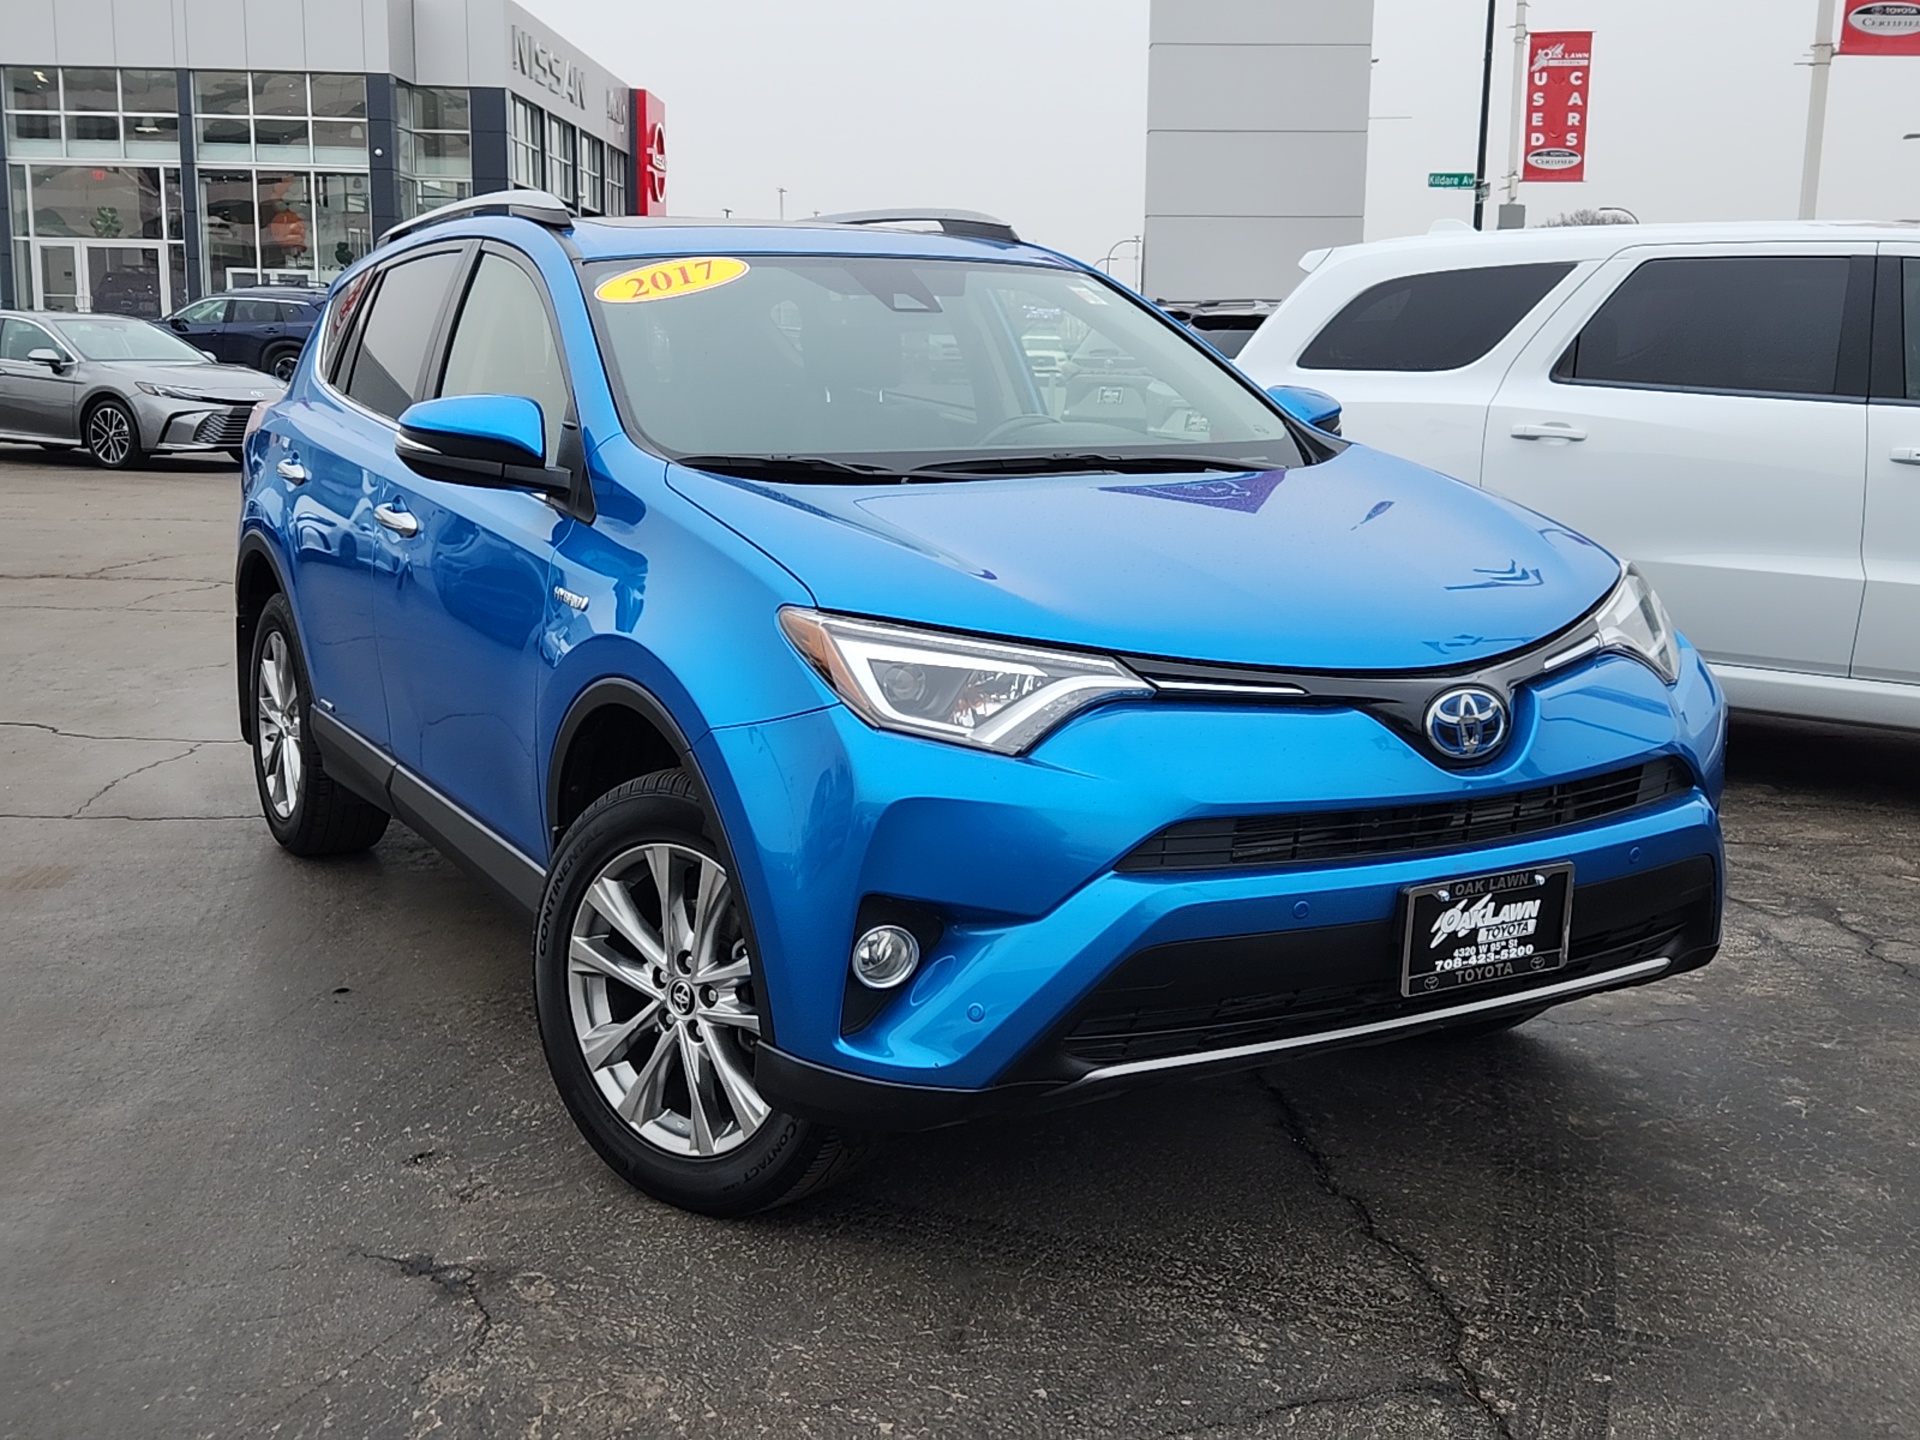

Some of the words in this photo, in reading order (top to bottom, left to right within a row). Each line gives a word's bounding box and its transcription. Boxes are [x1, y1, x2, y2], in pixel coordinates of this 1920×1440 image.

[511, 25, 586, 110] NISSAN
[1530, 72, 1548, 146] USED
[1565, 71, 1584, 146] CARS
[1430, 175, 1459, 186] Kildare
[1462, 175, 1474, 186] Av
[625, 260, 712, 298] 2017
[539, 830, 604, 957] CONTINENTAL
[1455, 882, 1486, 896] OAK
[1489, 873, 1530, 891] LAWN
[1484, 921, 1530, 940] TOYOTA
[1434, 944, 1535, 972] 708-423-5200
[1453, 945, 1477, 958] 4320
[1478, 944, 1489, 954] W
[1508, 938, 1519, 948] St
[1455, 962, 1514, 984] TOYOTA
